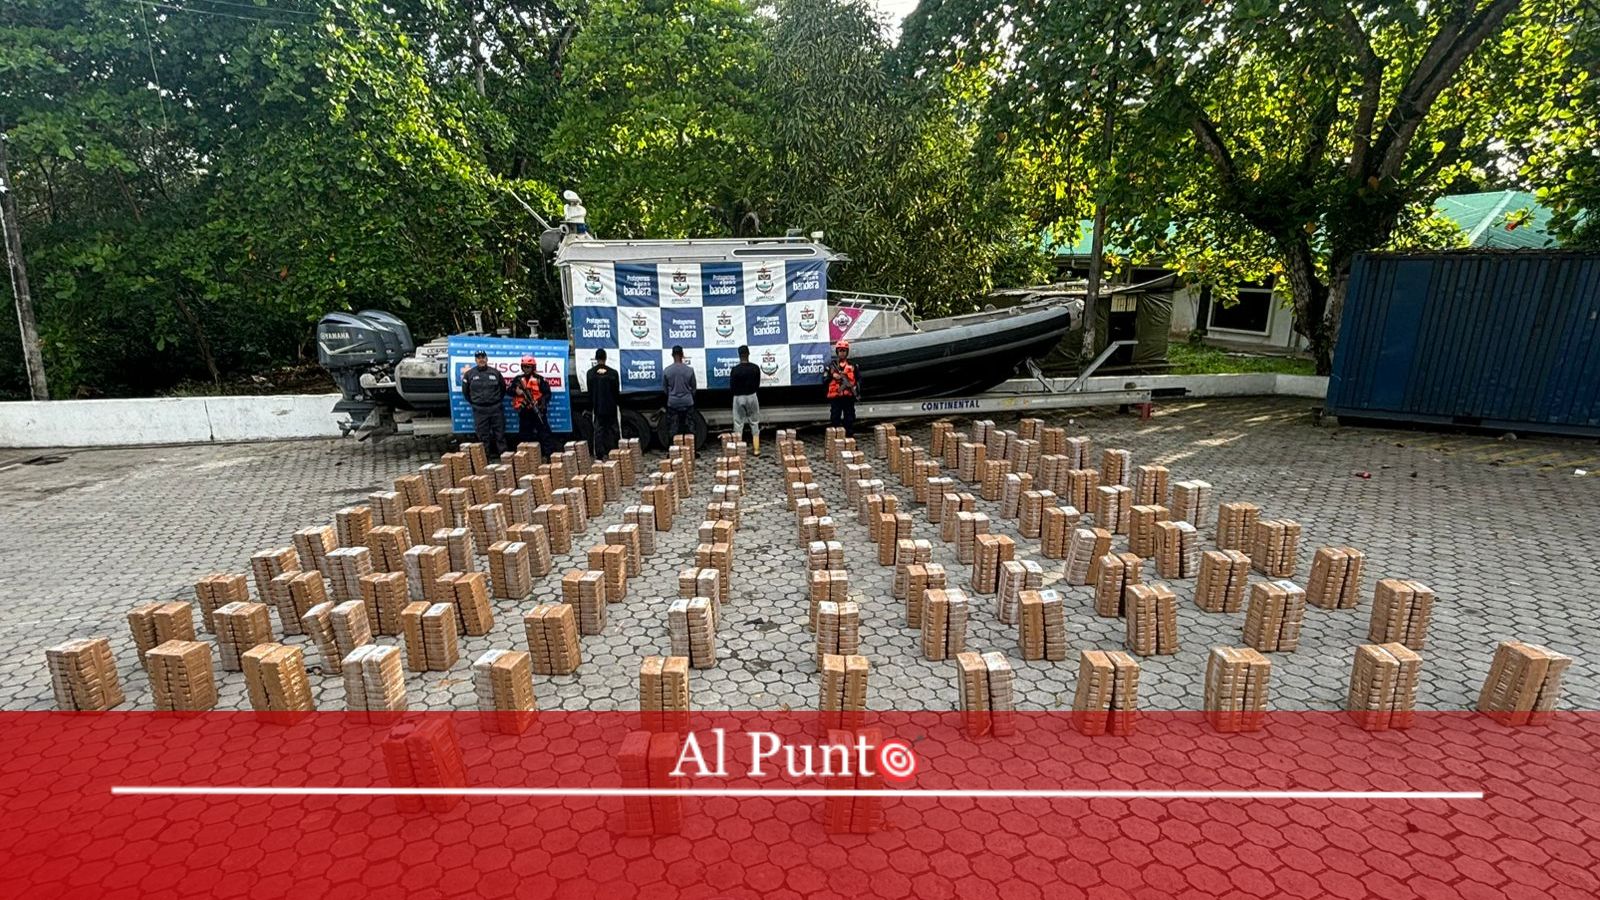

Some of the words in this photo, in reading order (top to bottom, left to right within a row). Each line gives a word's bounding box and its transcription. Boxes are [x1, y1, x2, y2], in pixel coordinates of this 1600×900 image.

[623, 285, 651, 296] bandera
[709, 284, 736, 295] bandera
[793, 280, 819, 291] bandera
[582, 327, 611, 338] bandera
[669, 329, 697, 339] bandera
[753, 326, 780, 336] bandera
[488, 360, 560, 374] ISCLÍA
[714, 367, 731, 377] band
[797, 363, 824, 374] bandera
[628, 369, 656, 379] bandera
[921, 400, 980, 411] CONTINENTAL
